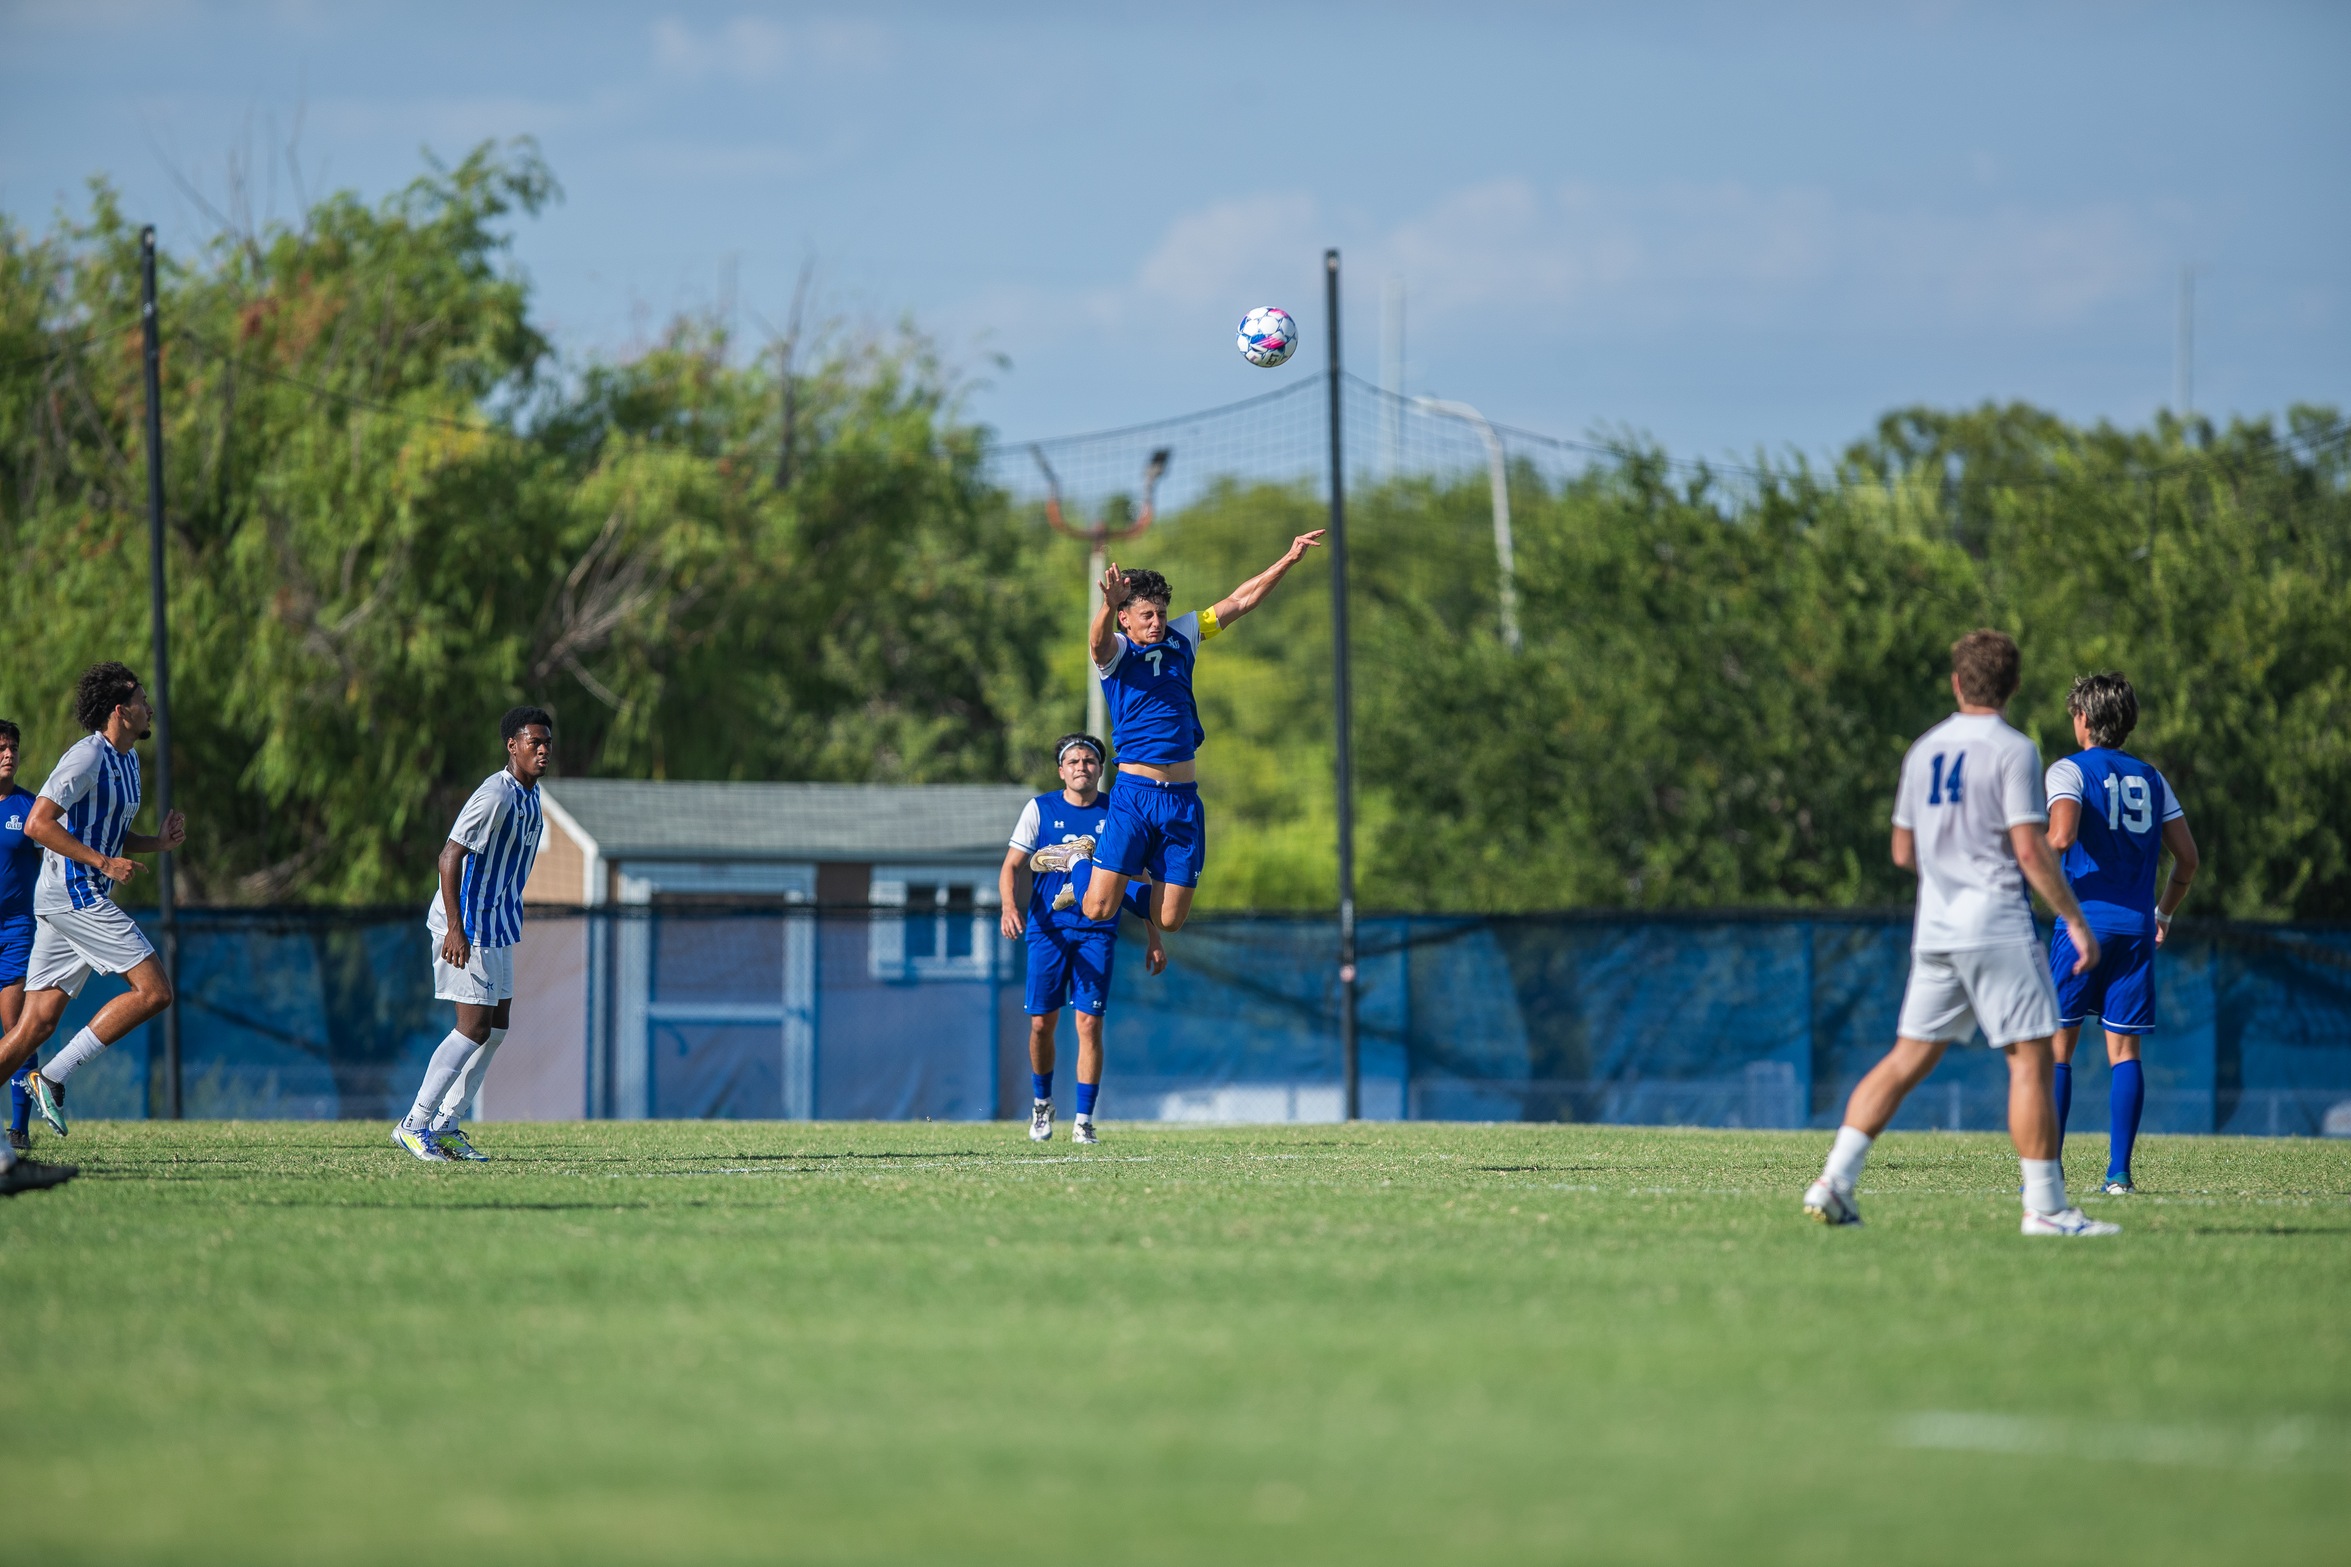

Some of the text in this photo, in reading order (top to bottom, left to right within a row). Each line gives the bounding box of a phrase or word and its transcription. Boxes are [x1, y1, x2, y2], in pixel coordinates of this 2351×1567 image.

[1145, 649, 1163, 677] 7
[1929, 750, 1966, 805] 14
[2103, 772, 2153, 834] 19
